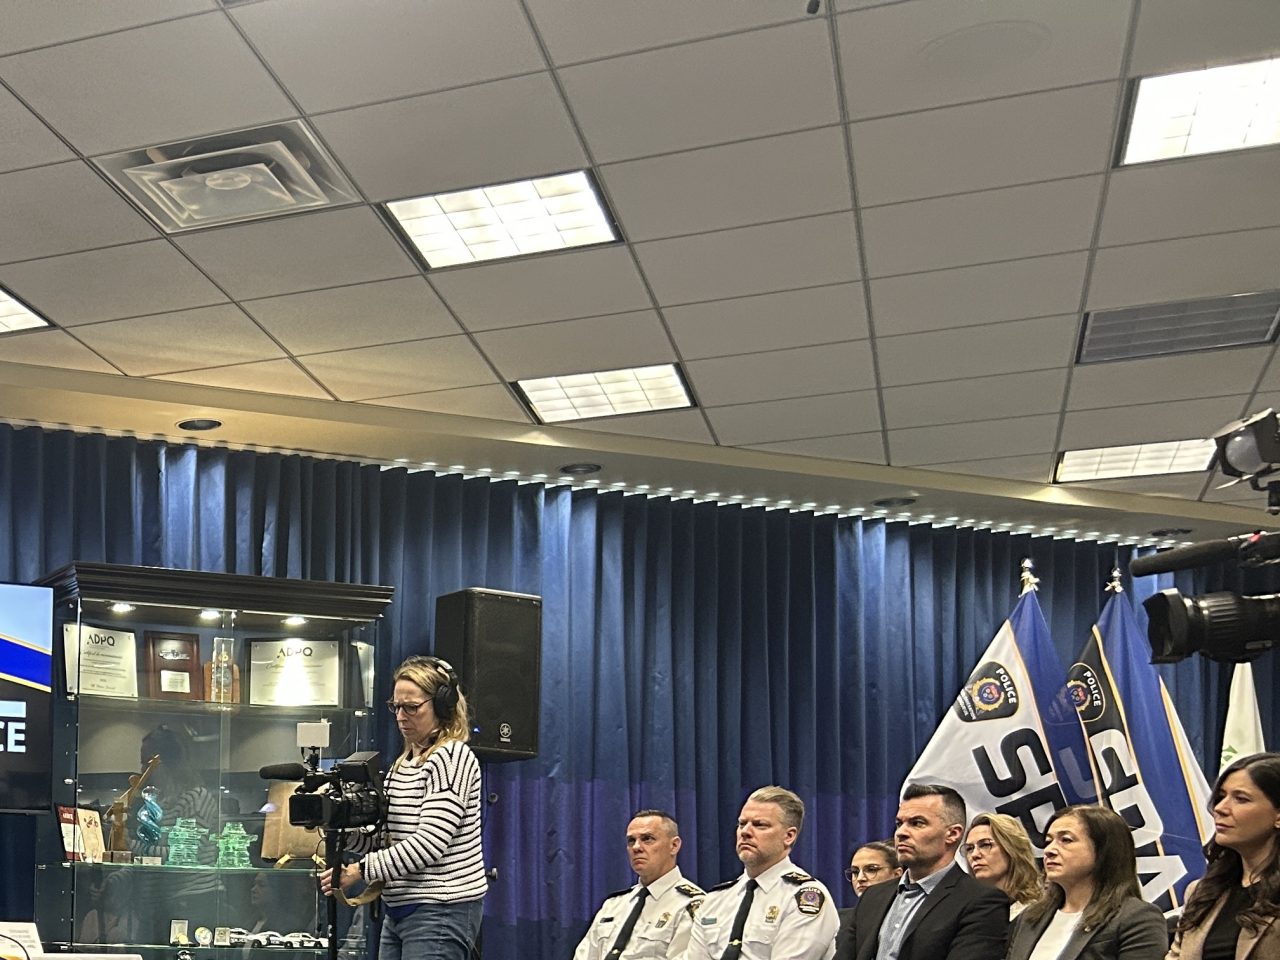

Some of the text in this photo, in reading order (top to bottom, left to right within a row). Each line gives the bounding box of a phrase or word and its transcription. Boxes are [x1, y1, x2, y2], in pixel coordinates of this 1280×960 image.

[86, 633, 116, 647] ADPQ
[995, 667, 1018, 705] POLICE
[1083, 670, 1102, 707] POLICE
